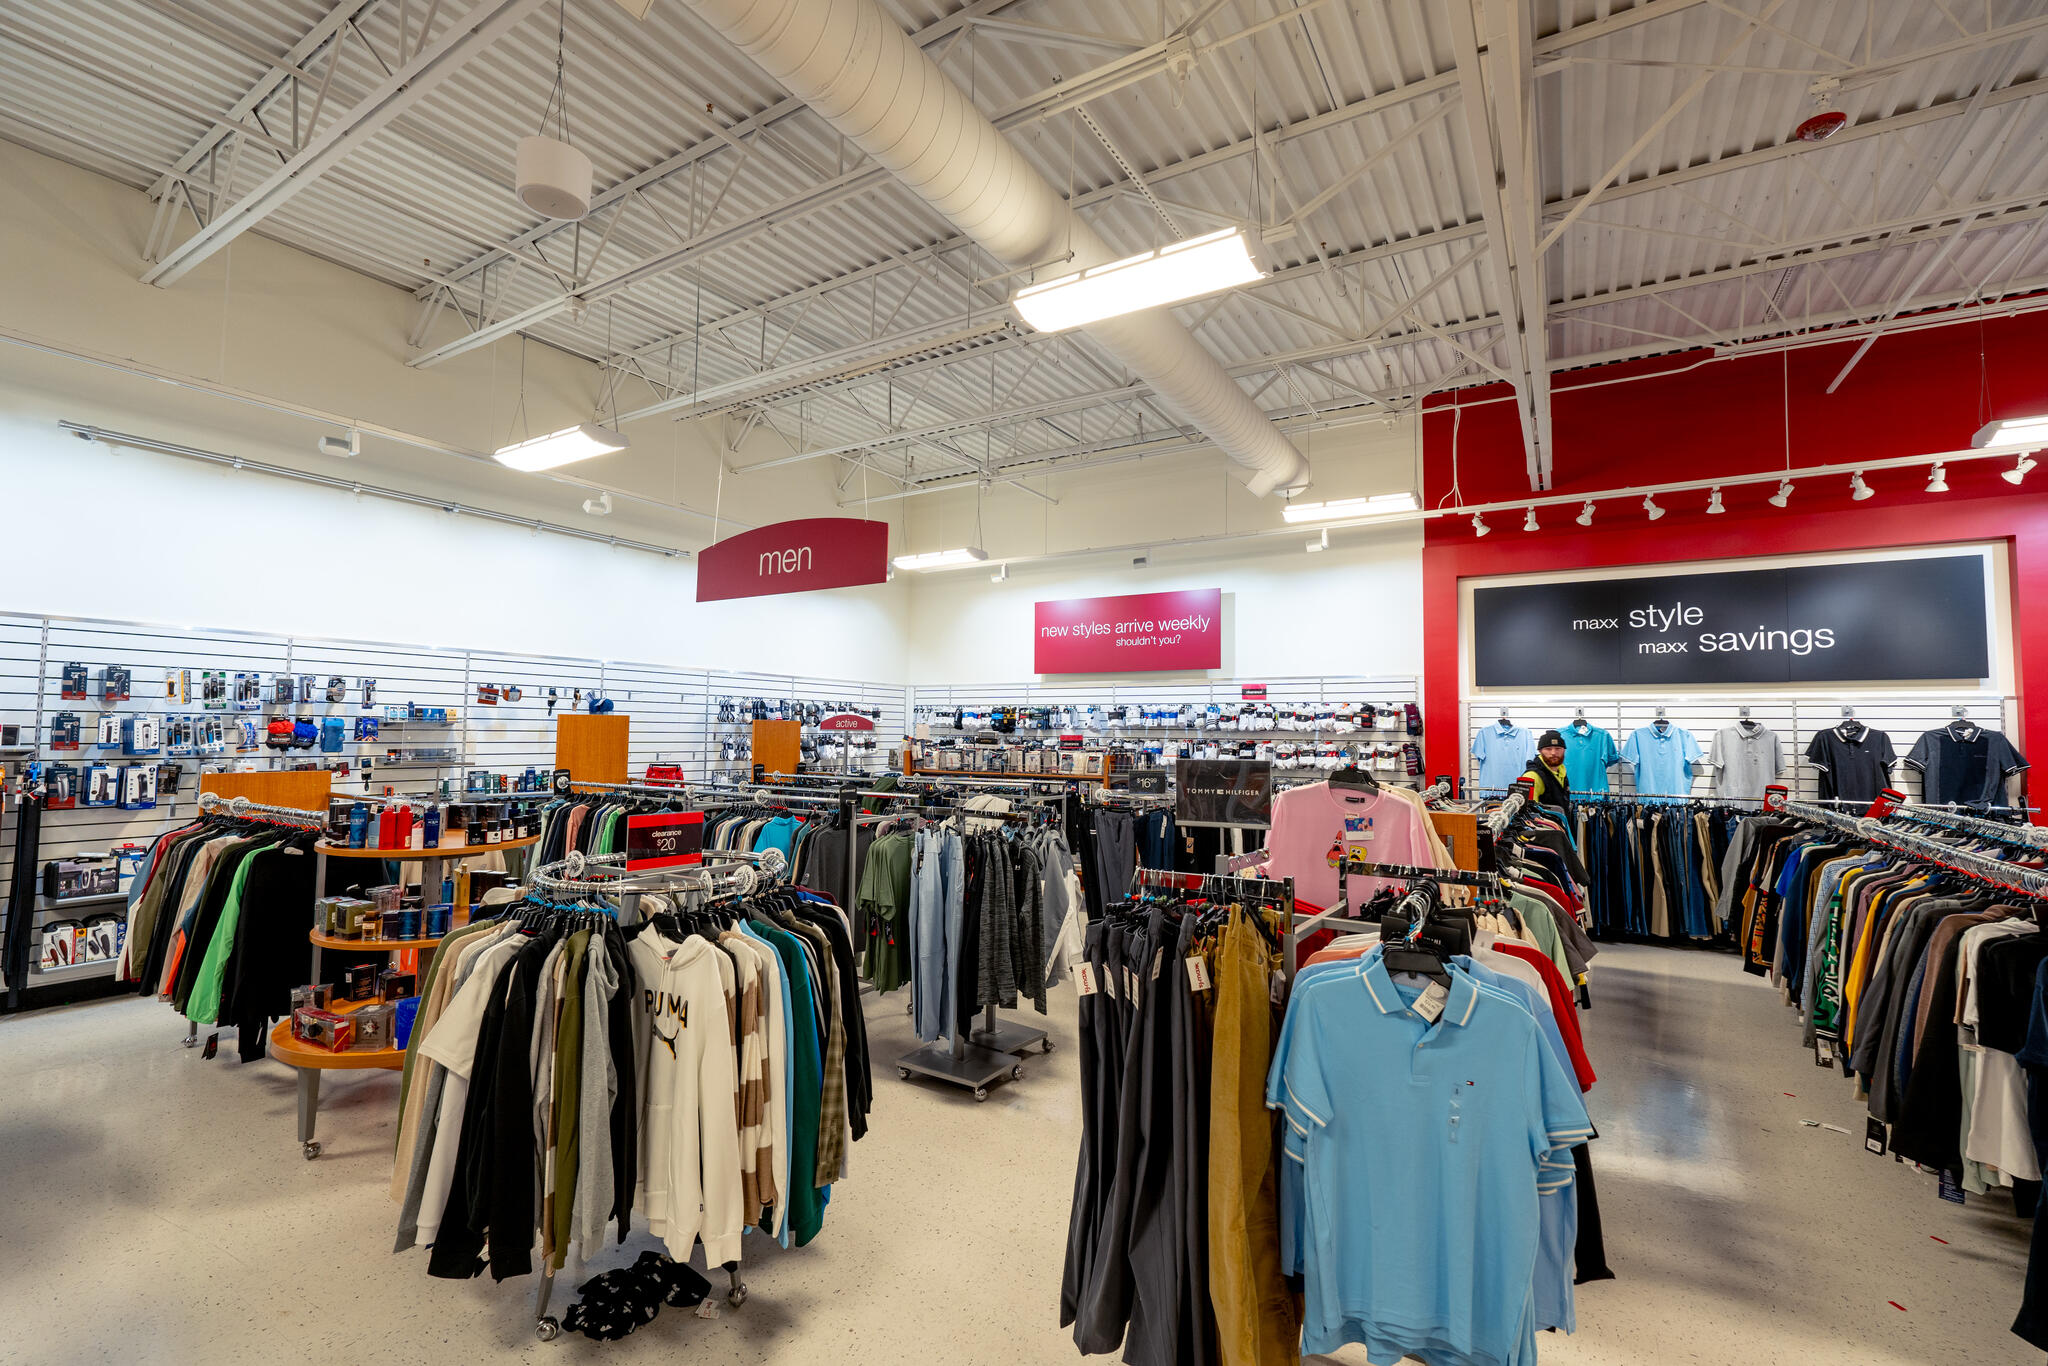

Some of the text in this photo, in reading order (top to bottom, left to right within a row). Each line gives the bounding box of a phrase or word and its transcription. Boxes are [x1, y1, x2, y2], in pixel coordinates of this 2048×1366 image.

[759, 546, 812, 576] men
[1041, 615, 1211, 639] new styles arrive weekly
[1573, 602, 1704, 632] maxx style
[1115, 634, 1182, 647] shouldn't you?
[1638, 625, 1836, 656] maxx savings
[835, 718, 858, 729] active
[651, 829, 682, 838] clearance
[657, 837, 676, 851] $20
[645, 989, 688, 1029] PUMA
